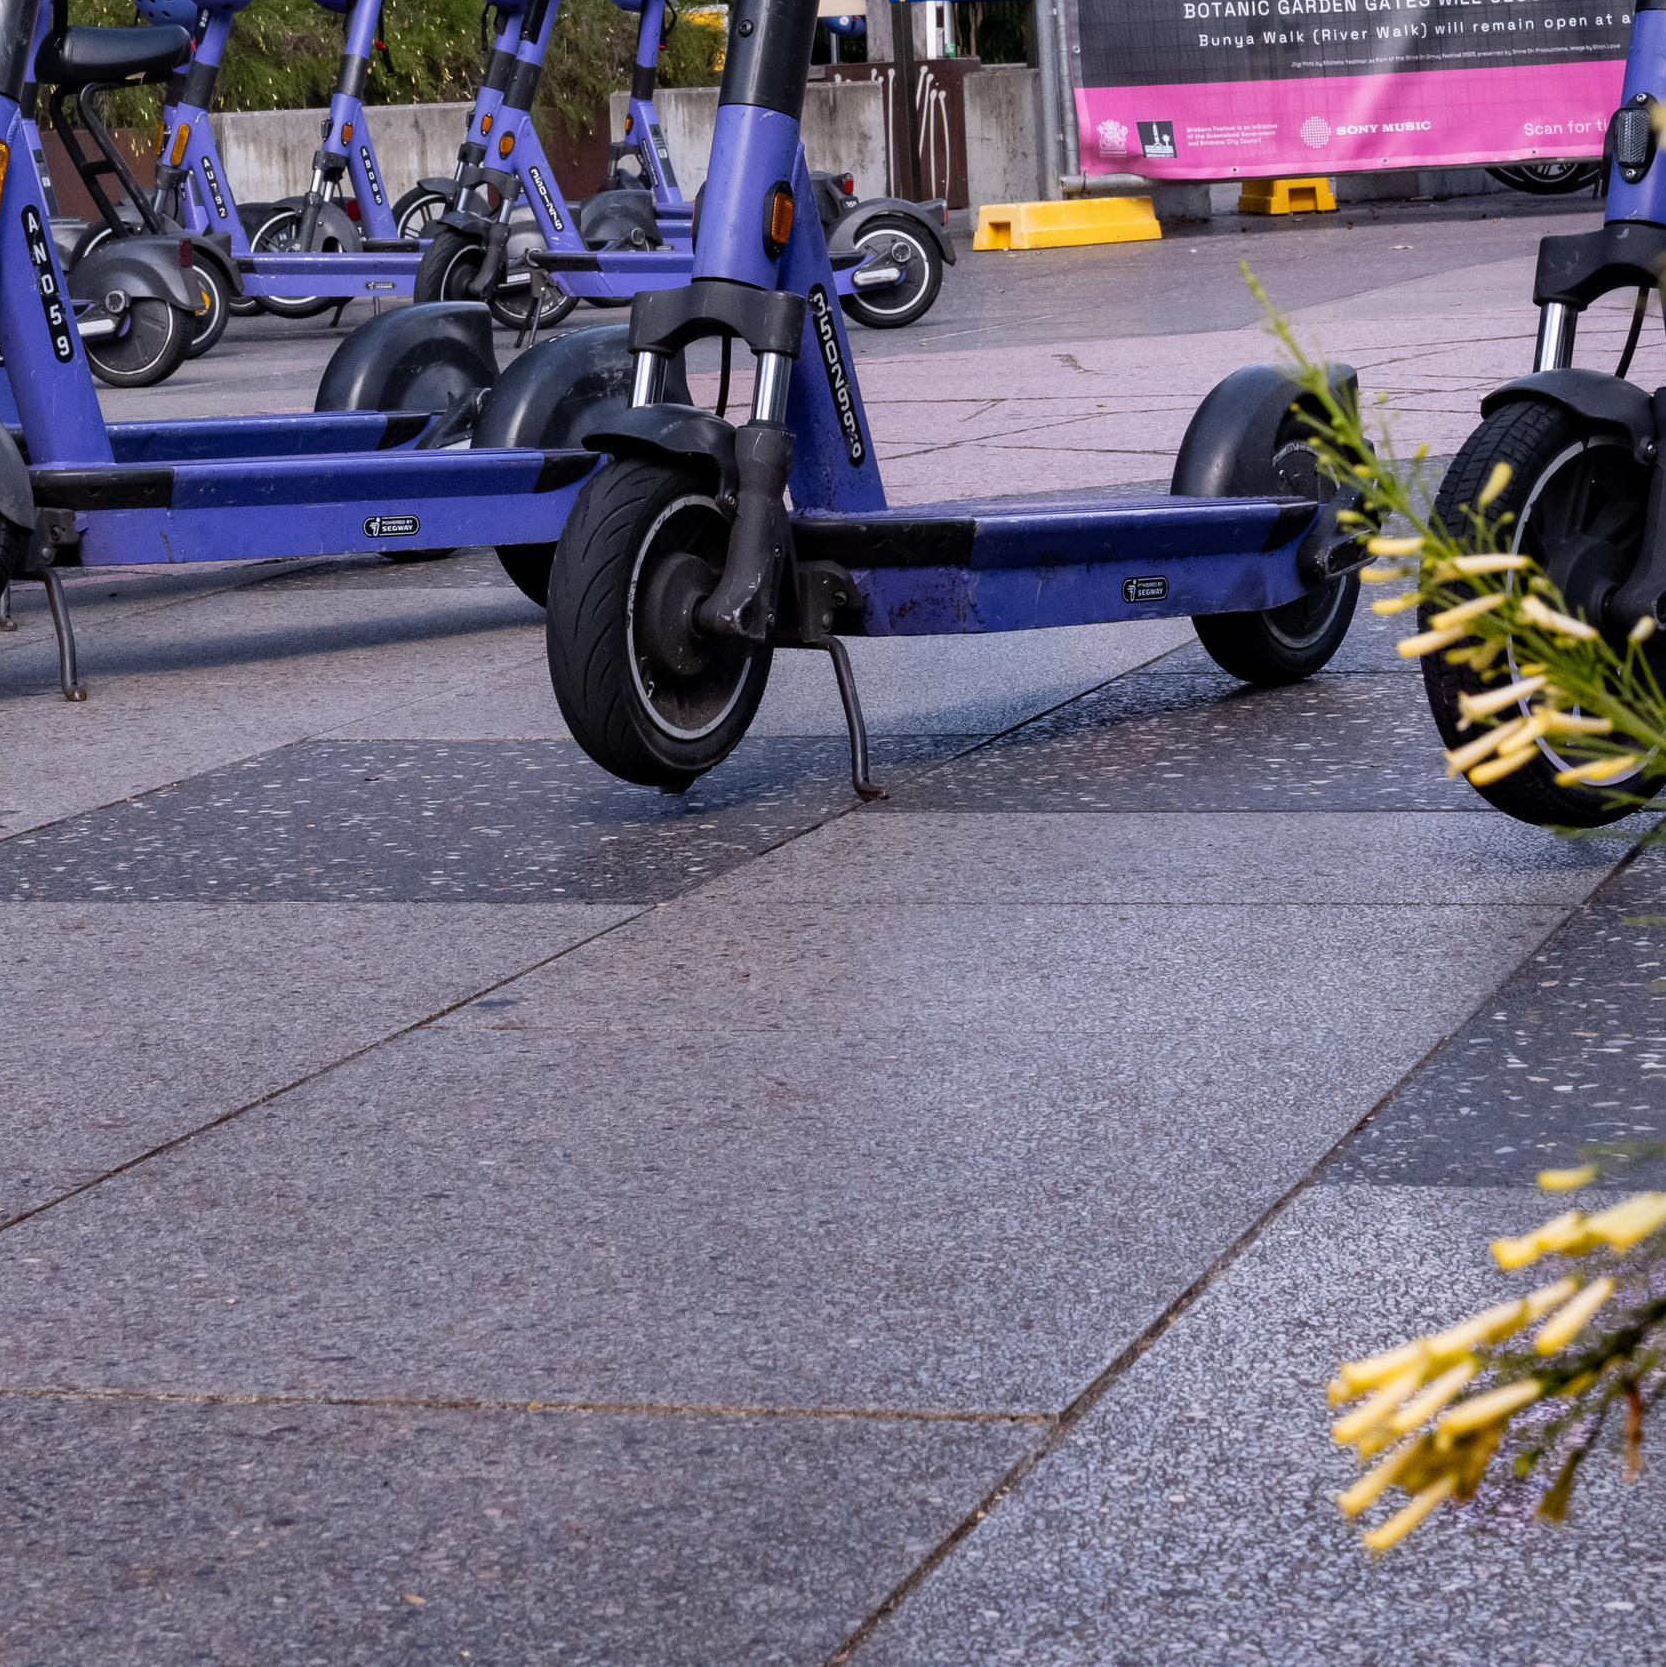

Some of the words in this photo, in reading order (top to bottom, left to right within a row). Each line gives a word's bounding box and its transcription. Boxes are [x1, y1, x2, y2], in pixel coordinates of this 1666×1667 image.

[1184, 0, 1270, 19] BOTANIC
[1198, 34, 1255, 48] Bunya
[1263, 30, 1305, 45] Walk
[1313, 28, 1368, 45] (River
[1376, 22, 1428, 39] Walk)
[1435, 21, 1464, 35] will
[1472, 18, 1534, 34] remain
[1544, 16, 1588, 31] open
[1595, 13, 1613, 25] at
[1336, 124, 1378, 136] SONY
[1382, 121, 1431, 133] MUSIC
[1523, 121, 1554, 136] Scan
[1567, 120, 1591, 135] for
[1137, 588, 1163, 596] SEGWAY
